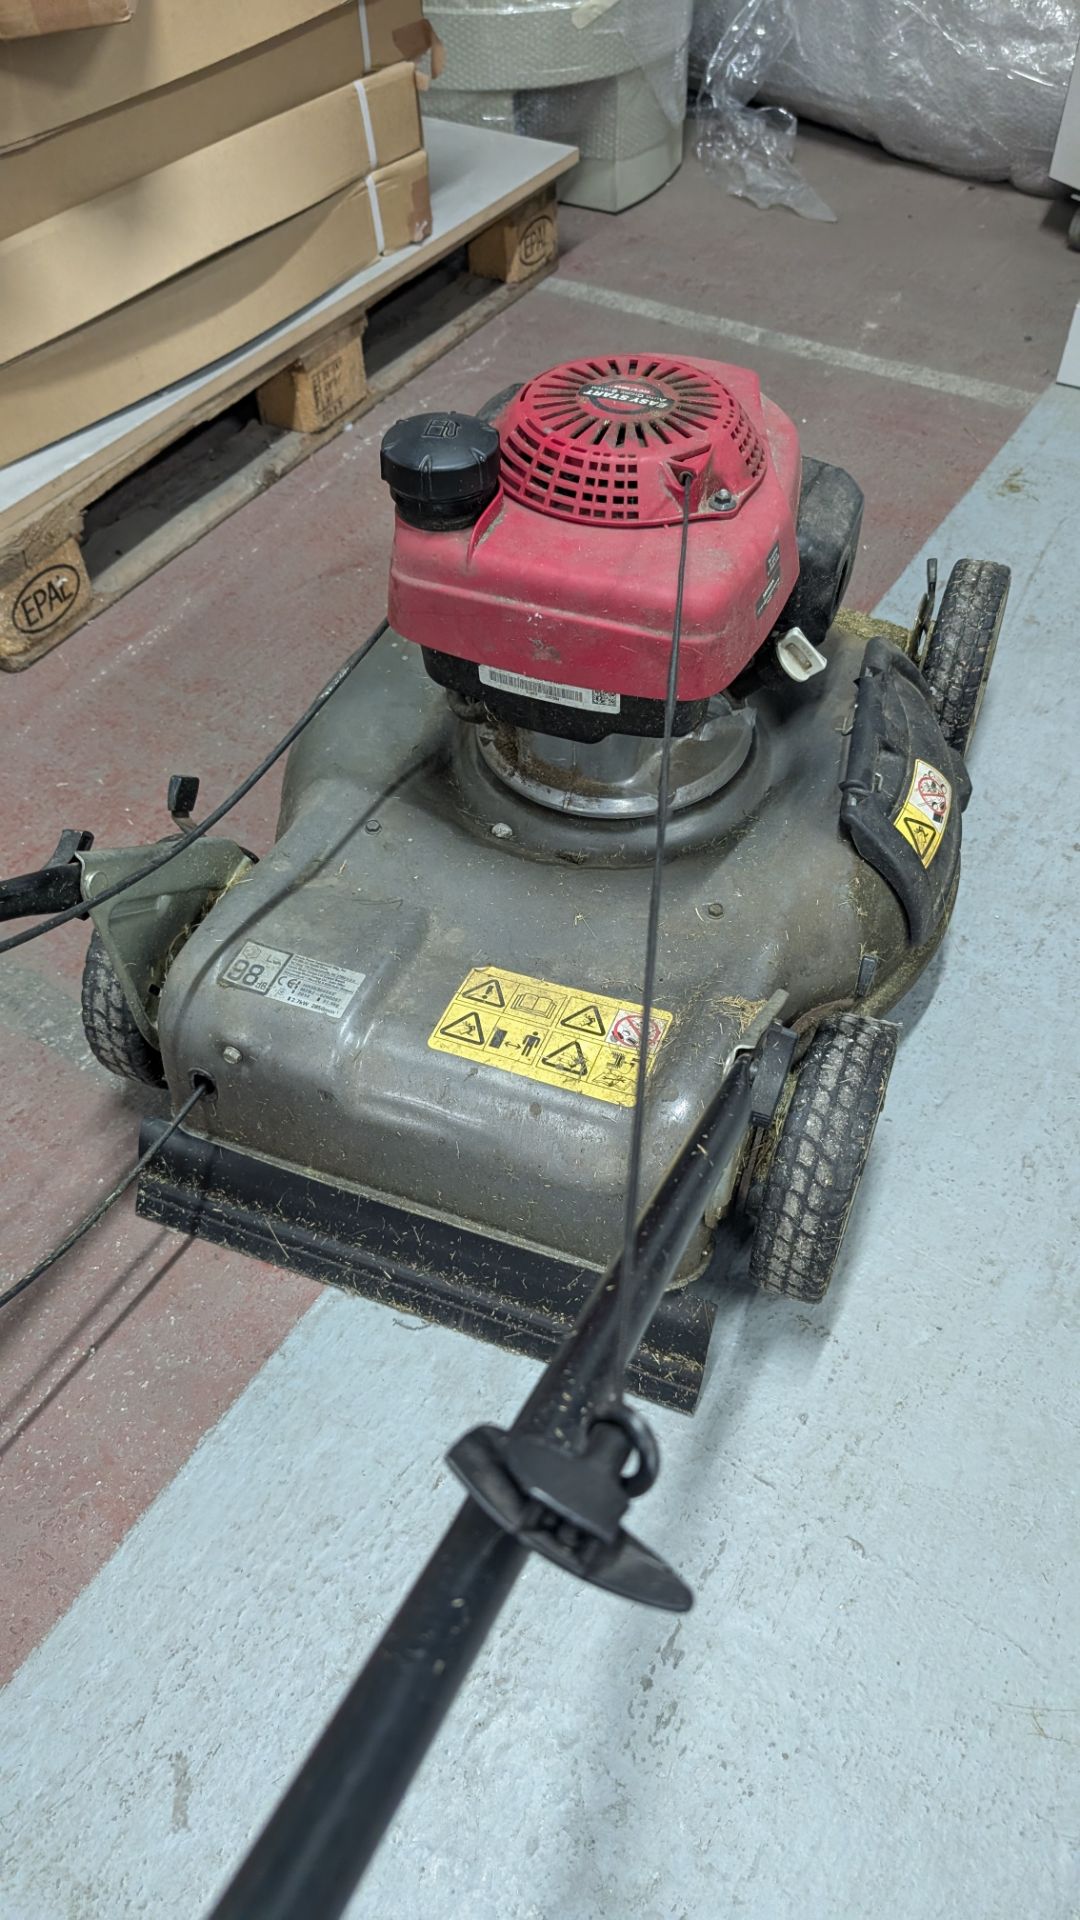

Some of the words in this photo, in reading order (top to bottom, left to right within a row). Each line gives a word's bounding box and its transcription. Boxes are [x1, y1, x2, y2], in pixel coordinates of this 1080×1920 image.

[582, 389, 630, 401] START
[629, 396, 668, 409] EASY
[20, 579, 74, 627] EPAL
[226, 959, 265, 986] 98
